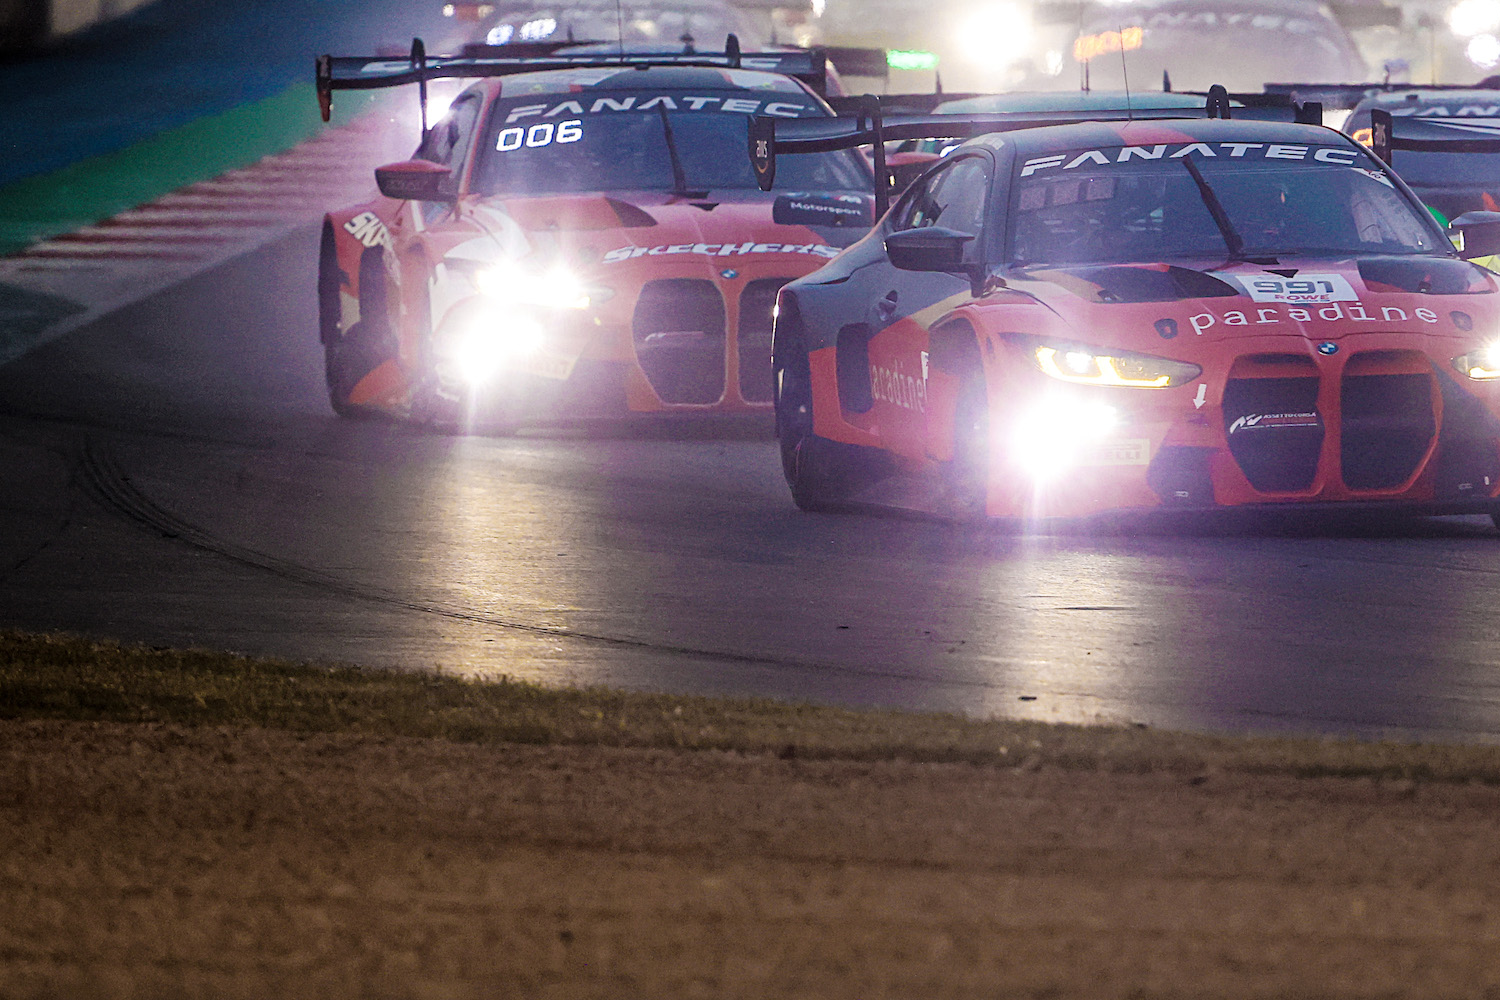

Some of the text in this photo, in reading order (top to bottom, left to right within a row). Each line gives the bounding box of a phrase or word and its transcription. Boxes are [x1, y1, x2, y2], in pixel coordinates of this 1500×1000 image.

[506, 95, 804, 123] FANATEC
[496, 119, 584, 151] 006
[1020, 143, 1358, 177] FANATEC
[790, 201, 862, 216] Motorsport
[603, 241, 845, 264] SKECHERS
[1253, 280, 1334, 294] 991
[1189, 302, 1438, 335] paradine
